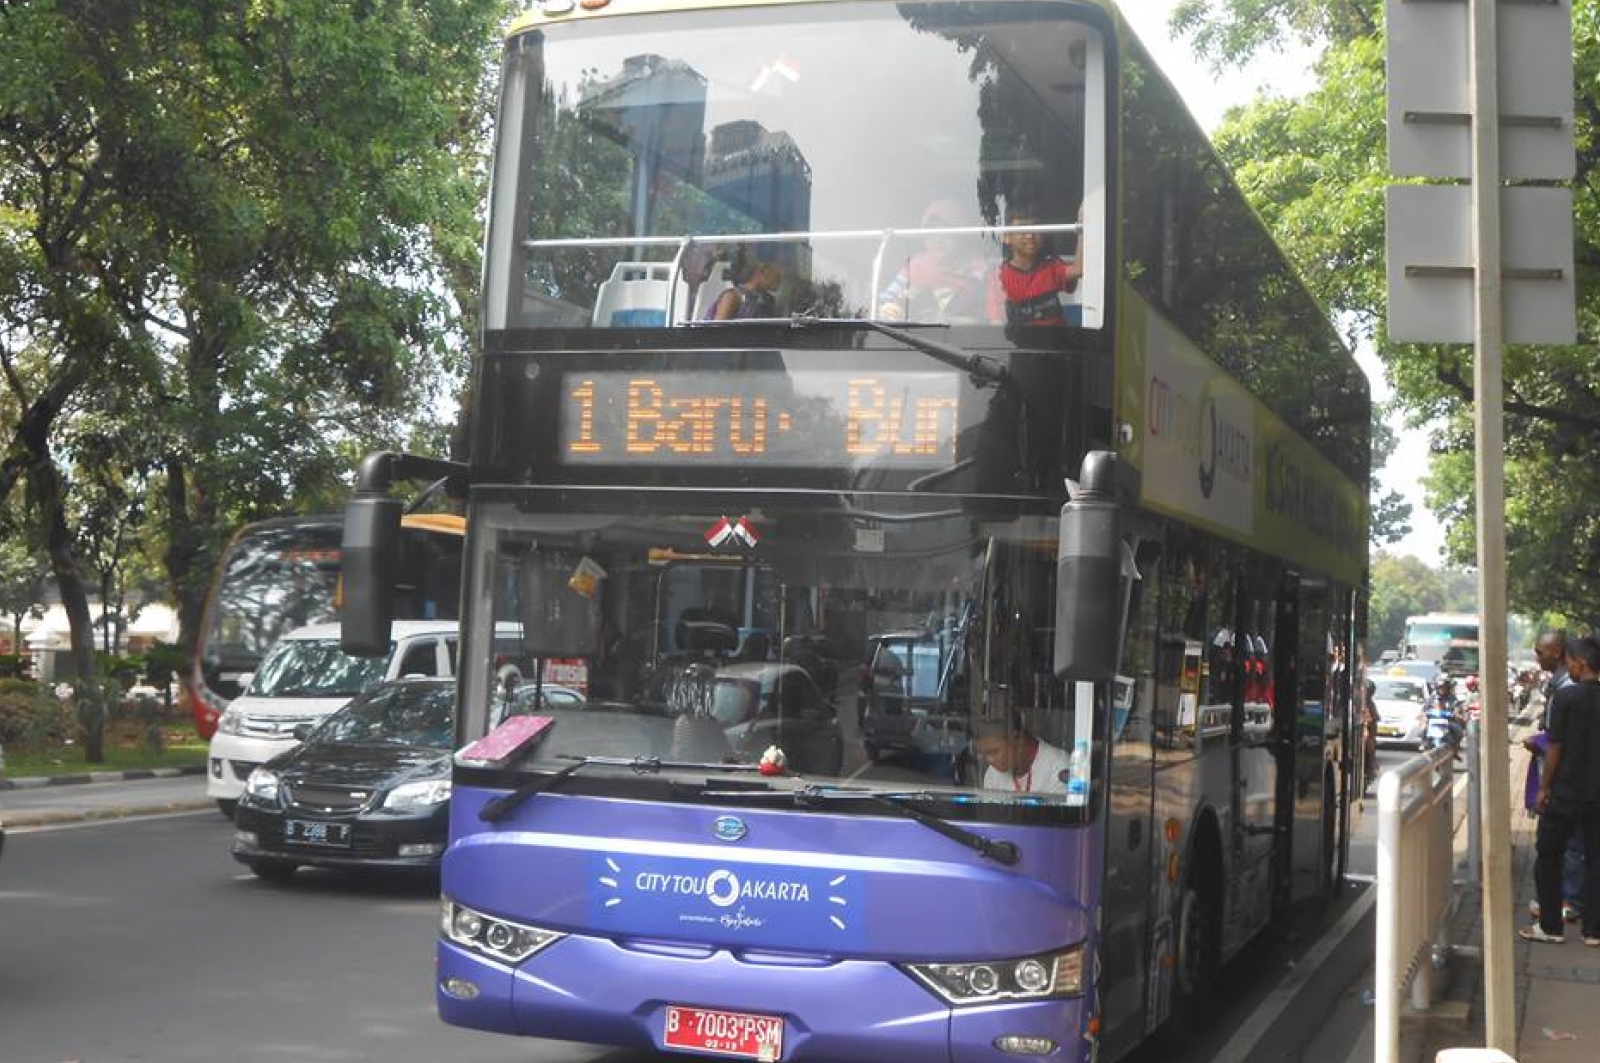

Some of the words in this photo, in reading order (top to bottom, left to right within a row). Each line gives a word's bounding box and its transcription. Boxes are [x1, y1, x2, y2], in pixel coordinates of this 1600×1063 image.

[635, 871, 675, 894] CITY
[668, 1010, 679, 1033] B
[694, 1011, 739, 1039] 7003
[744, 1018, 780, 1045] PSM
